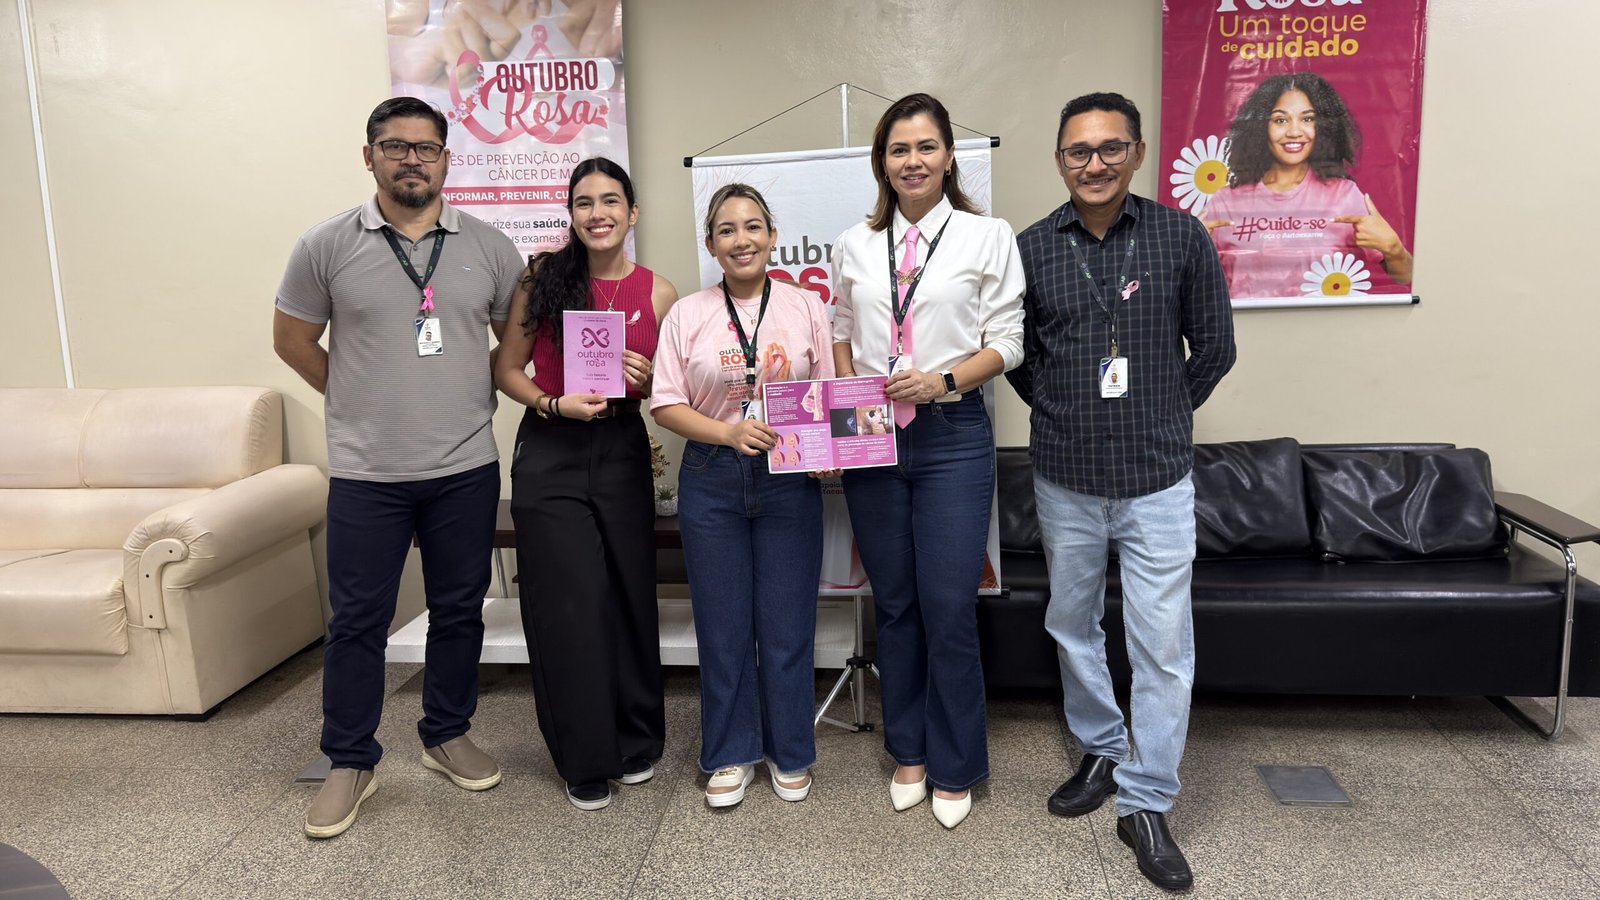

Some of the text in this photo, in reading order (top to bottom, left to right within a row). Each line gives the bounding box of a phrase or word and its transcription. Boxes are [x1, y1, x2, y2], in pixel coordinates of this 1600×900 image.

[1220, 14, 1367, 38] Um toque
[1221, 34, 1359, 60] de cuidado
[496, 60, 598, 93] OUTUBRO
[480, 74, 598, 135] Rosa
[450, 151, 580, 167] ÊS DE PREVENÇÃO AO
[488, 167, 538, 181] CÂNCER
[541, 168, 556, 179] DE
[442, 190, 569, 202] NFORMAR, PREVENIR, CU
[513, 220, 531, 229] sua
[532, 218, 568, 228] saúde
[1232, 216, 1327, 242] #Cuide-se
[521, 235, 561, 244] exames
[767, 235, 834, 266] tubr
[578, 350, 614, 359] outubro
